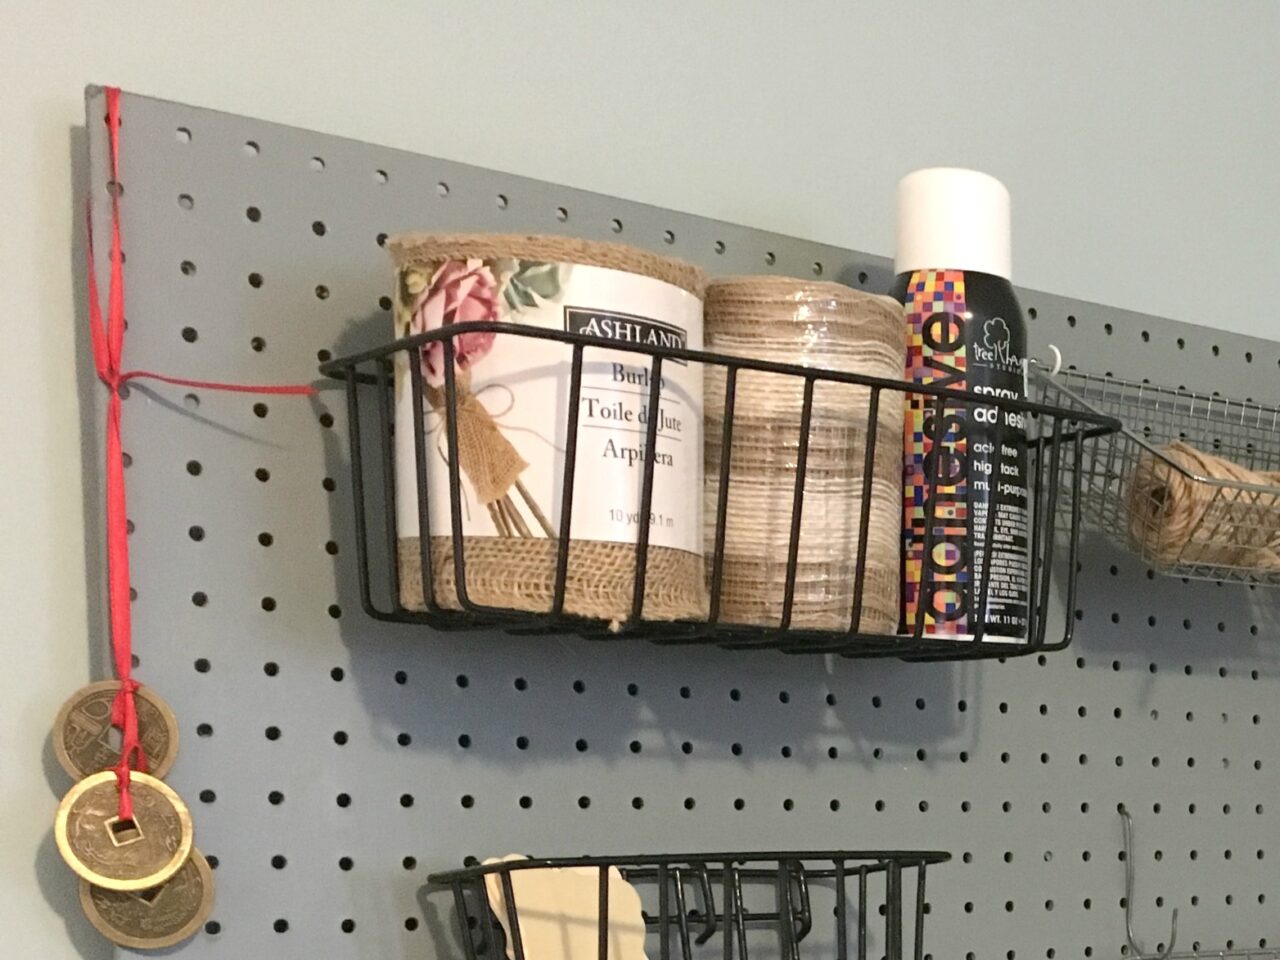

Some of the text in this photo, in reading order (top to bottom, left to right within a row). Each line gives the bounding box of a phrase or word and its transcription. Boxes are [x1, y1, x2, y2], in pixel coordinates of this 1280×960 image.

[581, 397, 682, 432] Toile d Jute
[602, 438, 674, 468] Arpiera
[973, 442, 1018, 458] aci free
[911, 311, 967, 622] adhesve
[973, 460, 1019, 477] hig tack
[609, 508, 623, 522] 10
